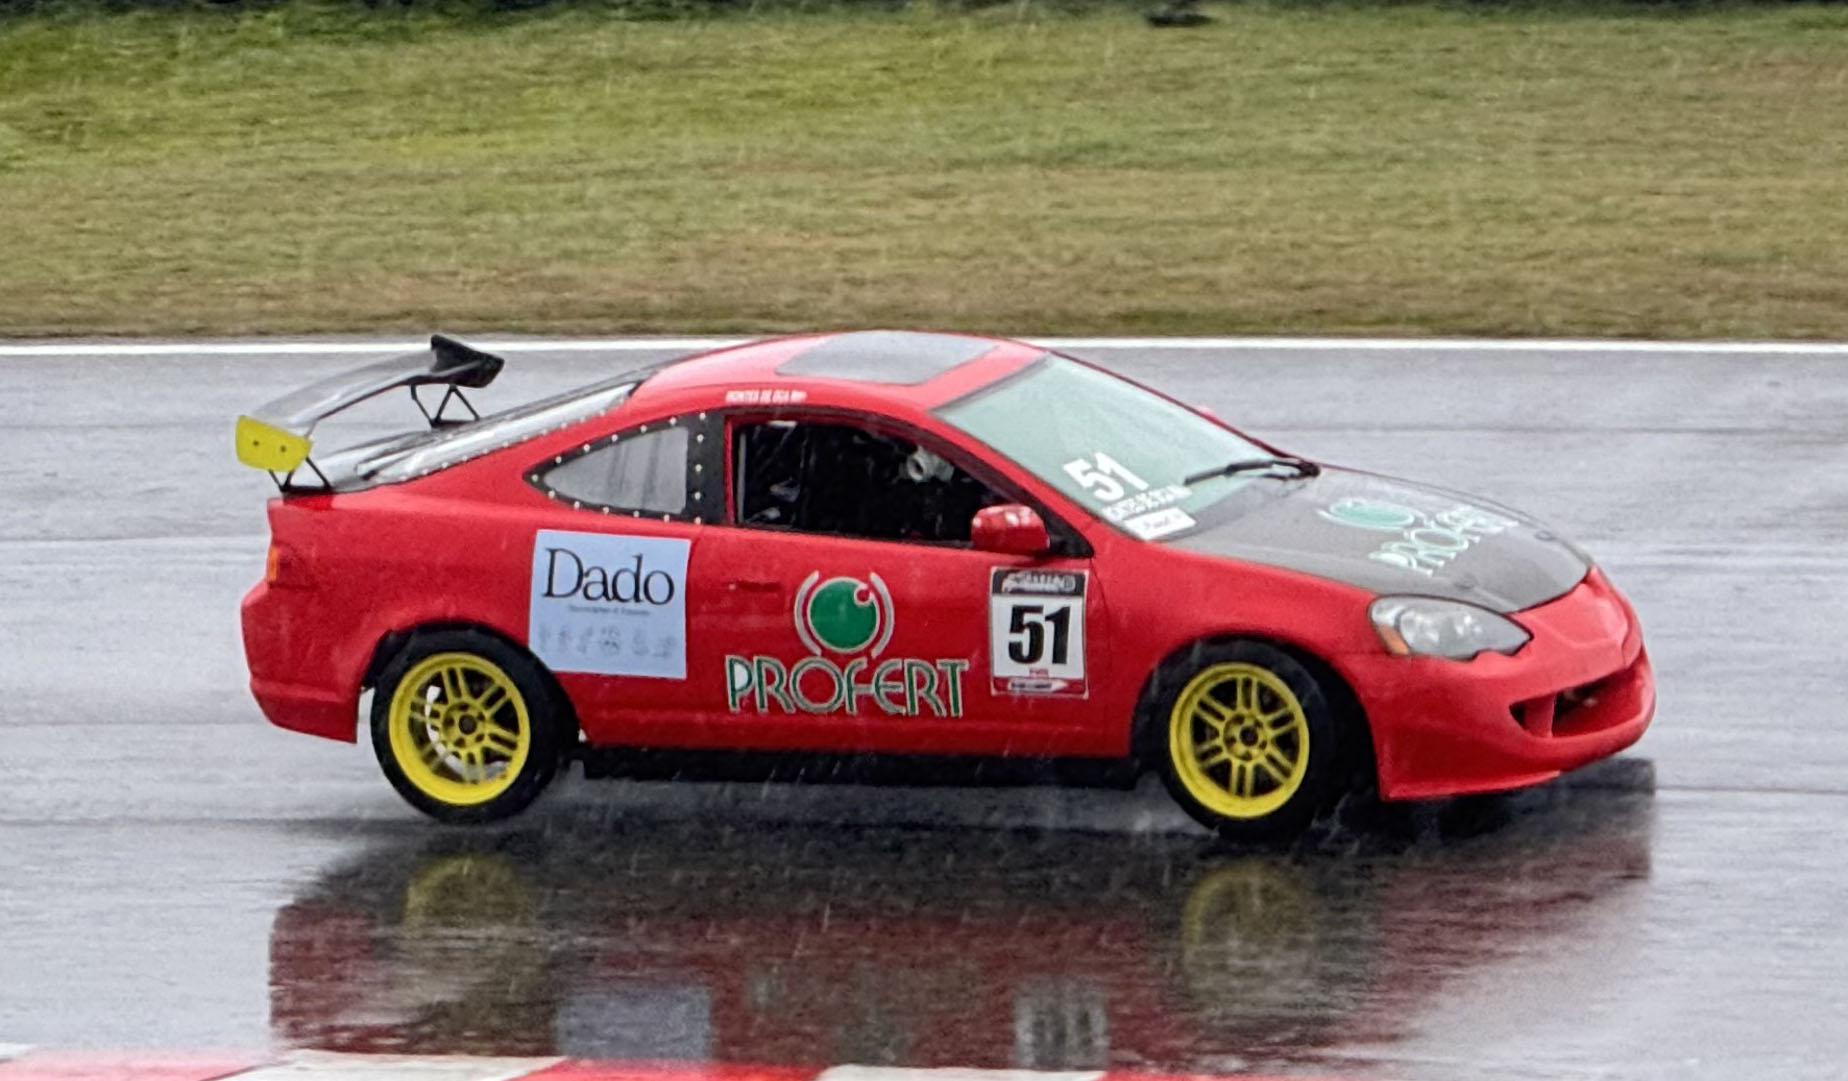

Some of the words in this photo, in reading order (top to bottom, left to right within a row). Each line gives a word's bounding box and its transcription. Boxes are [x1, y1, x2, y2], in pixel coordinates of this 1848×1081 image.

[1062, 451, 1150, 502] 51
[542, 547, 675, 606] Dado
[1008, 604, 1071, 665] 51
[725, 654, 970, 718] PROFERT
